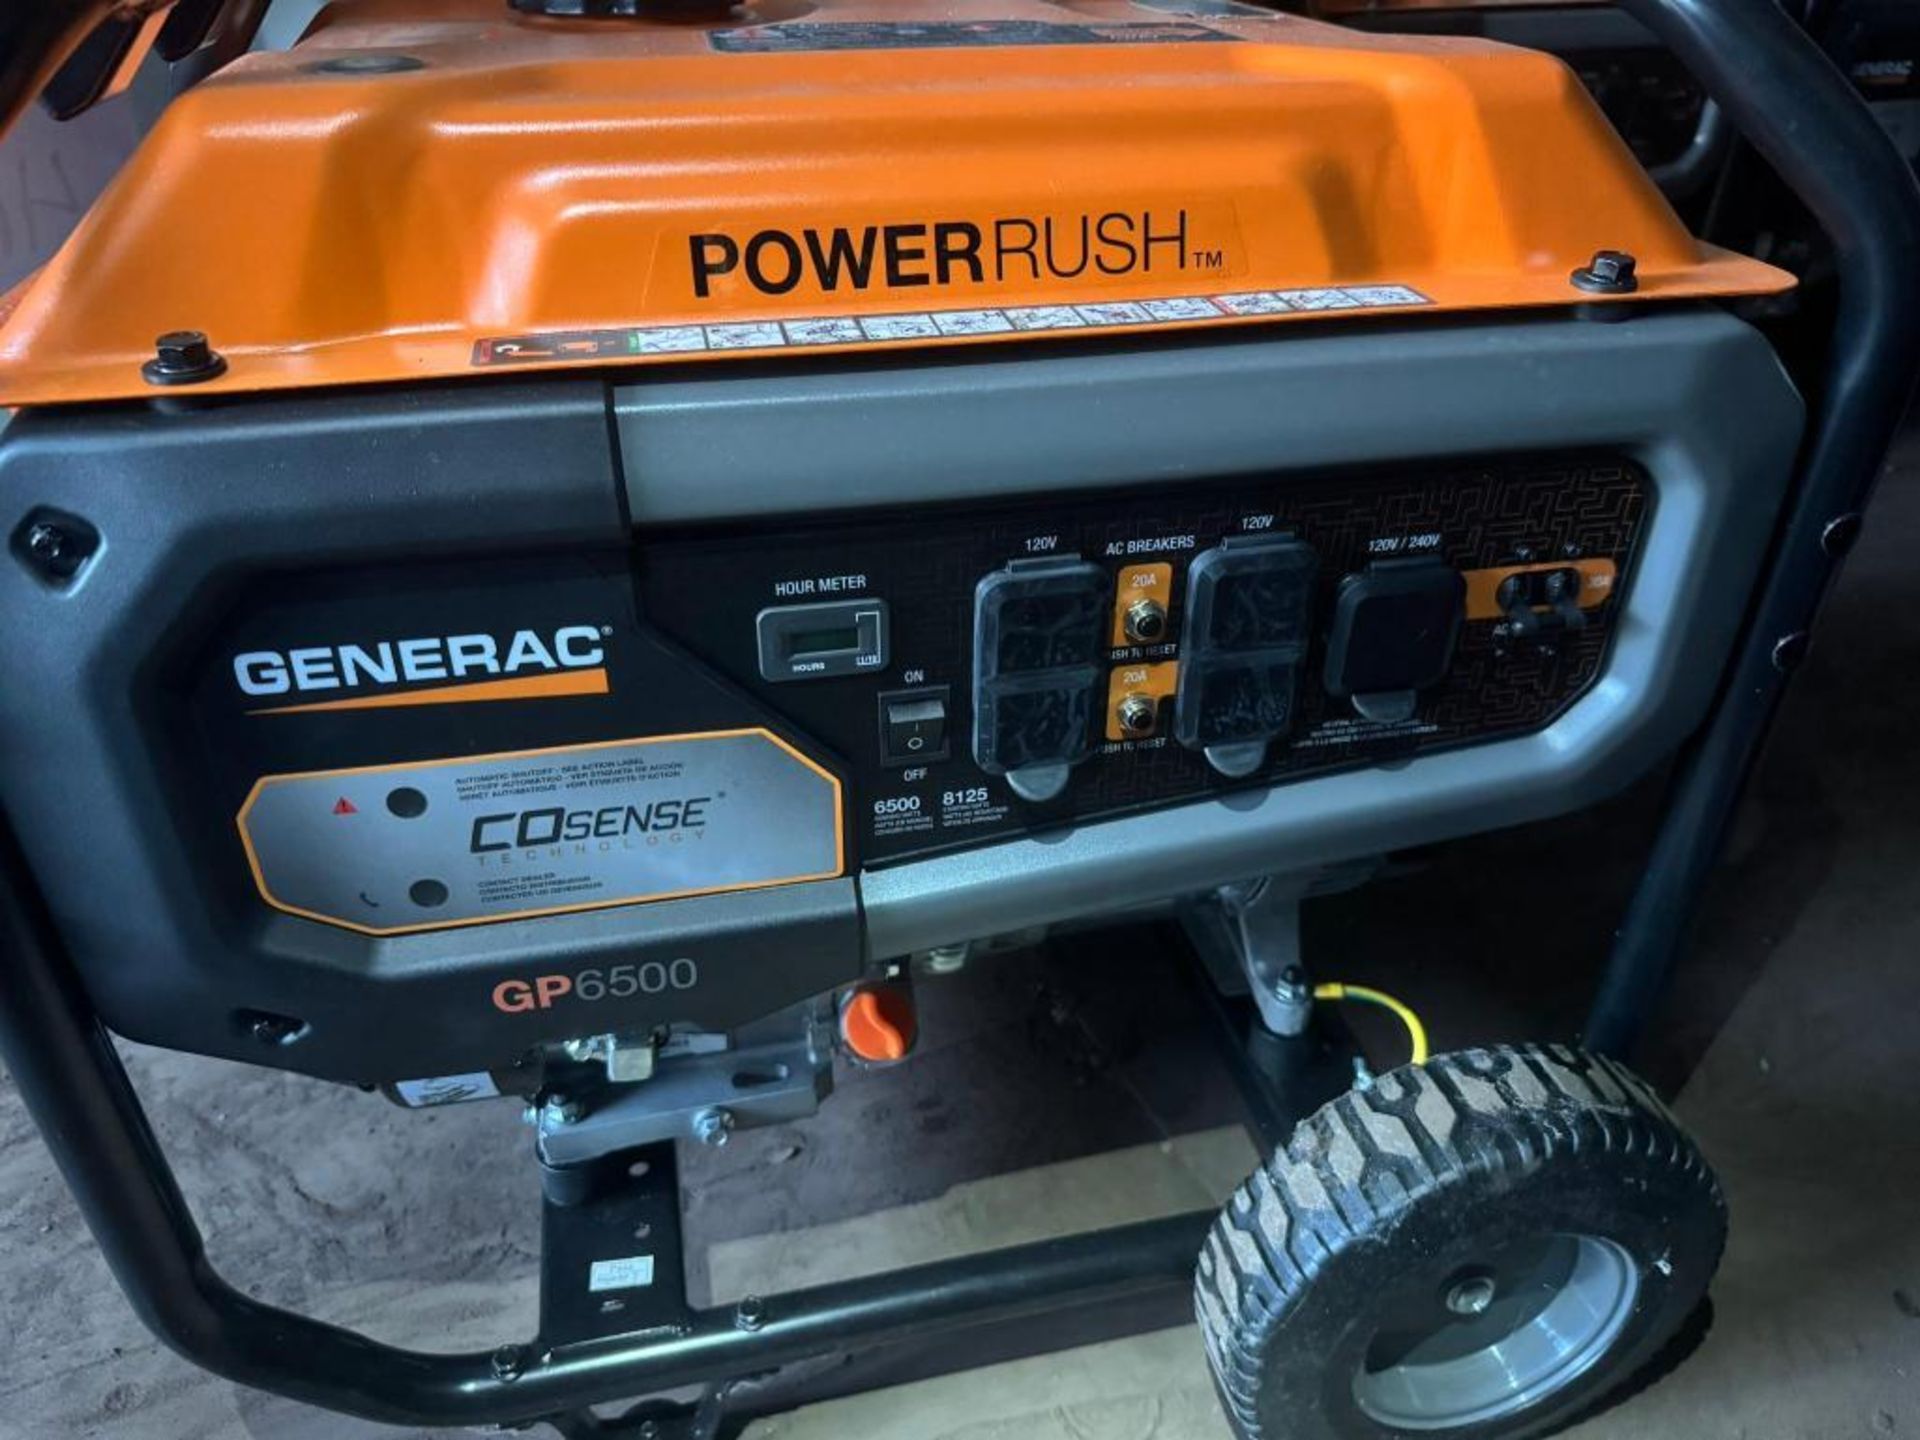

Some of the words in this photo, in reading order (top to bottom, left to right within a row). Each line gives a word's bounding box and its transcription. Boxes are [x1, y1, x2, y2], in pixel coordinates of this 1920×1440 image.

[690, 208, 1188, 298] POWERRUSH
[1242, 514, 1274, 530] 120V
[1025, 535, 1058, 551] 120V
[1106, 541, 1123, 556] AC
[1127, 534, 1196, 553] BREAKERS
[1368, 537, 1398, 552] 120V
[1408, 533, 1441, 550] 240V
[775, 580, 815, 596] HOUR
[818, 575, 866, 593] METER
[1132, 573, 1157, 588] 20A
[792, 661, 825, 672] HOURS
[904, 669, 924, 683] ON
[1123, 669, 1149, 684] 20A
[904, 768, 928, 782] OFF
[874, 795, 920, 814] 6500
[943, 788, 988, 806] 8125
[470, 797, 711, 854] COSENSE
[478, 830, 706, 866] TECHNOLOGY
[492, 958, 698, 1013] GP6500
